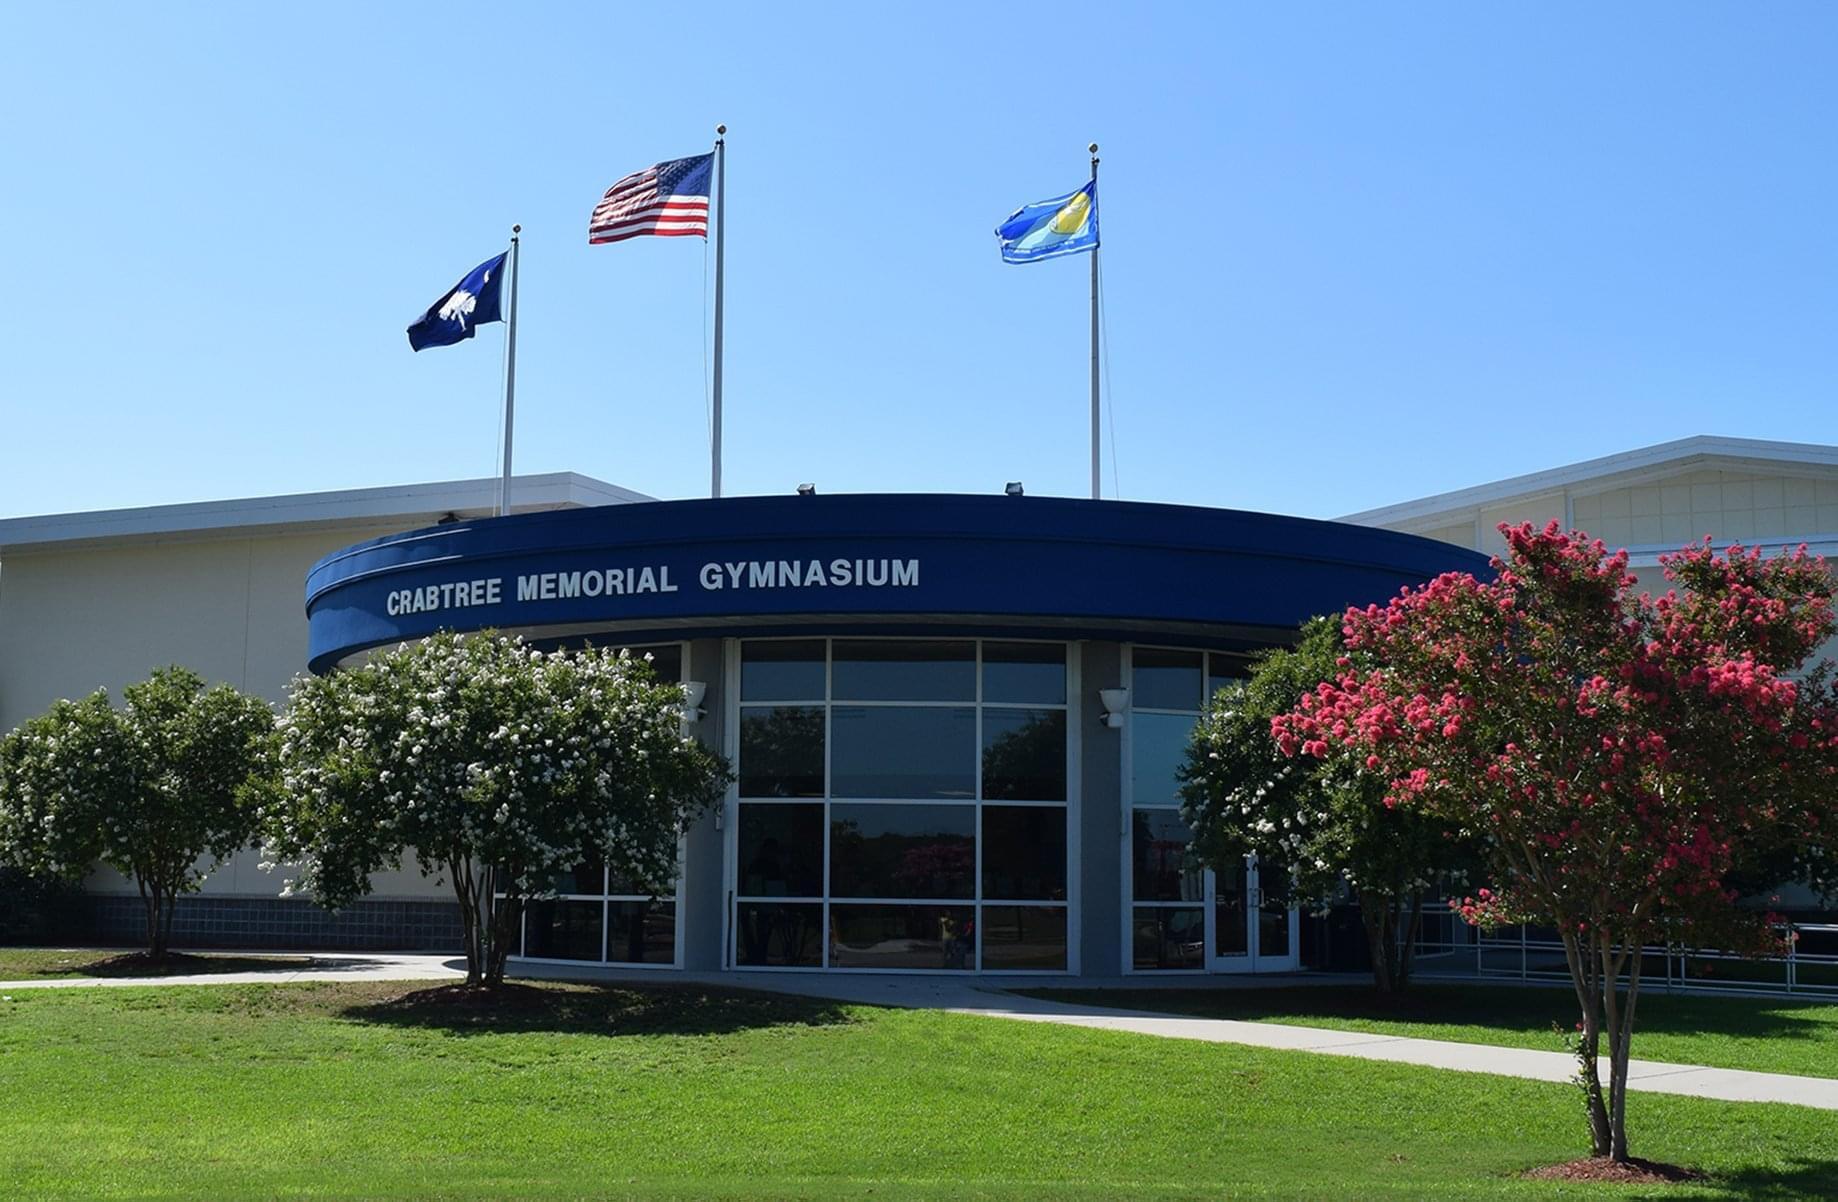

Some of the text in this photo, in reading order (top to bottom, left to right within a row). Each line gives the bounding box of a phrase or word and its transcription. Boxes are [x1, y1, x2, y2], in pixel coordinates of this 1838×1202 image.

[387, 559, 919, 616] CRABTREE MEMORIAL GYMNASIUM
